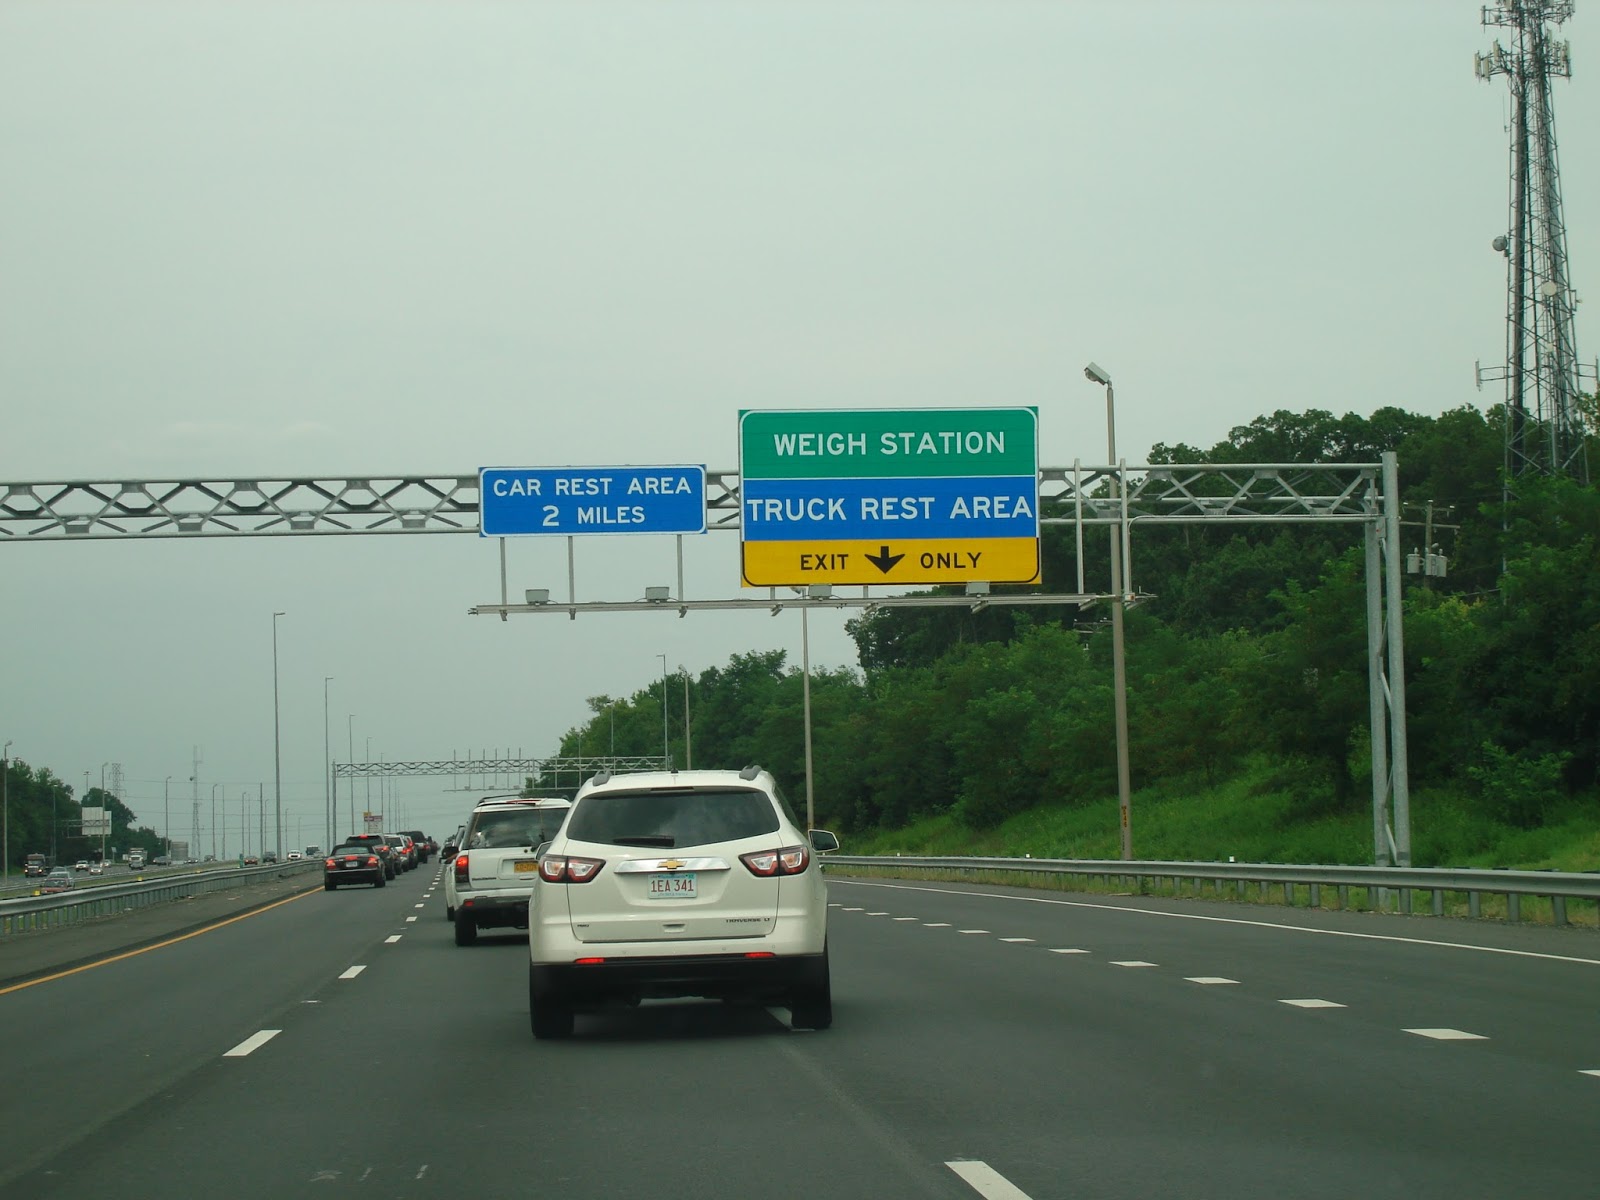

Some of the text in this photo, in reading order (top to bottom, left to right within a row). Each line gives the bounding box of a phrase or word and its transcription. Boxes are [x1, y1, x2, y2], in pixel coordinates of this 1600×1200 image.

[774, 431, 1005, 456] WEIGH STATION
[493, 476, 692, 497] CAR REST AREA
[542, 505, 646, 527] 2 MILES
[747, 496, 1033, 521] TRUCK REST AREA
[800, 552, 982, 570] EXIT ONLY
[651, 879, 694, 893] 1EA 341
